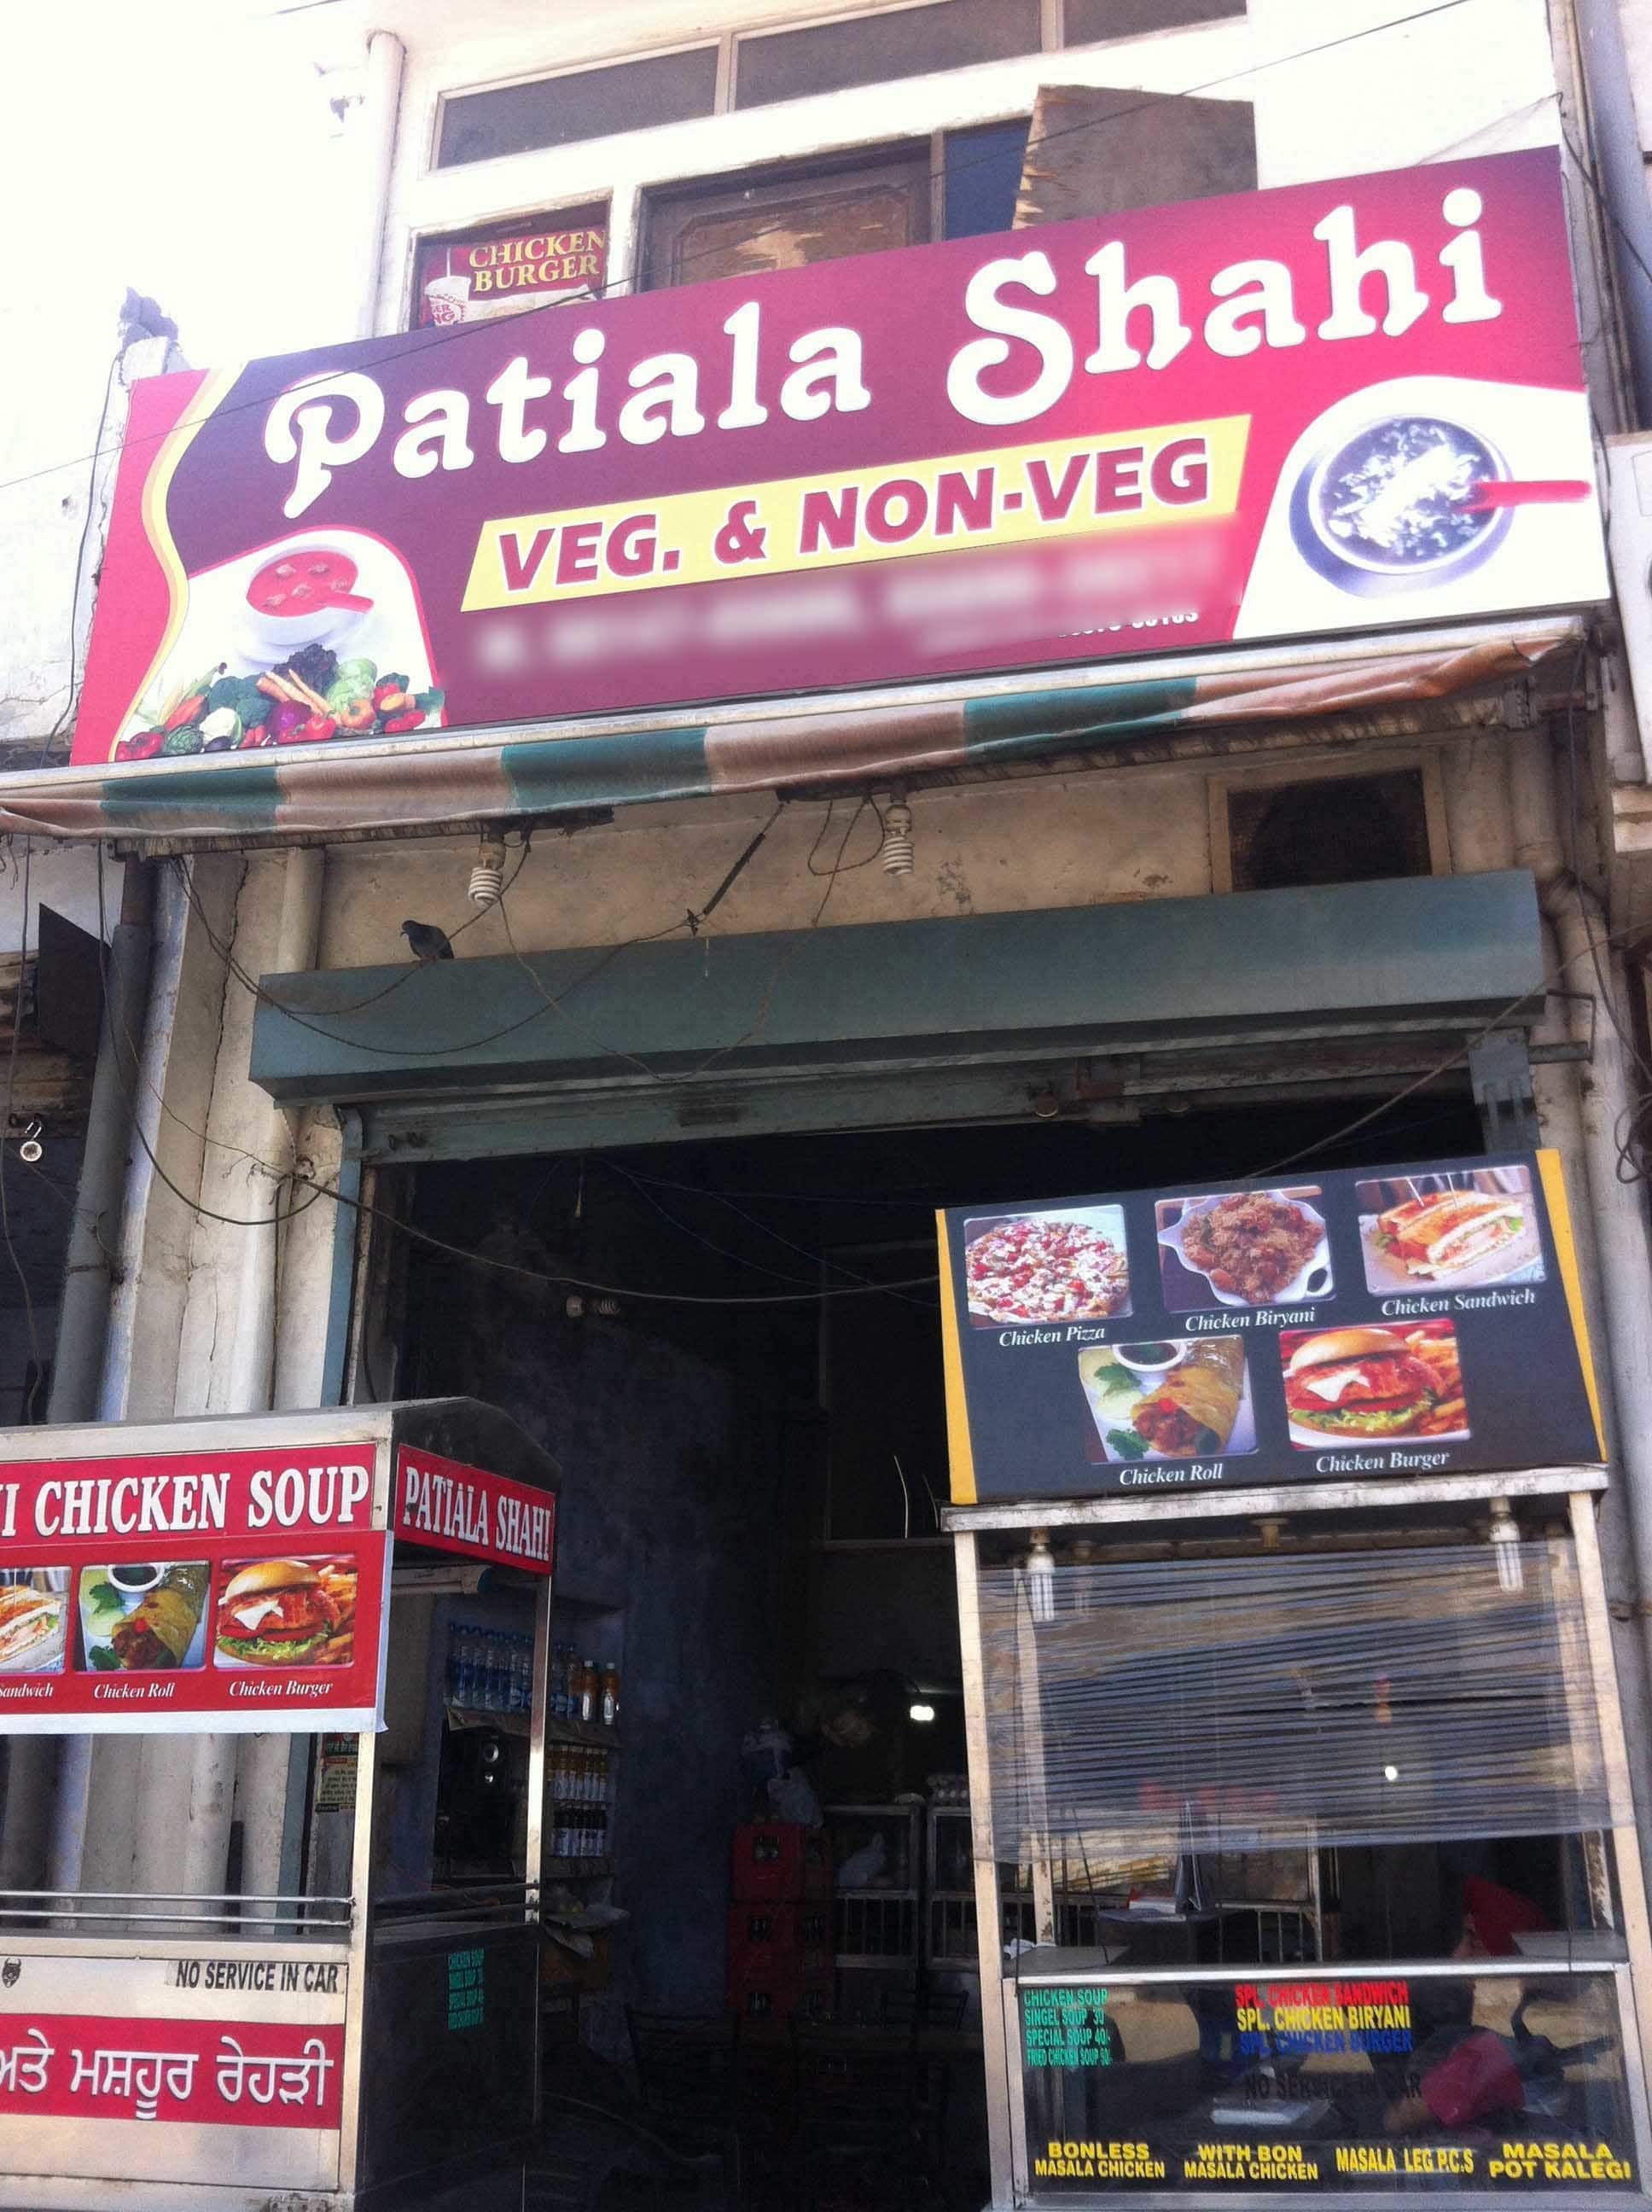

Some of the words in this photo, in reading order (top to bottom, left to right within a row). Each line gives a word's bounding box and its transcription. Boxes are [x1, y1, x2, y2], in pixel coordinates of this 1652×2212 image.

[469, 231, 605, 268] CHICKEN
[474, 255, 599, 292] BURGER
[264, 301, 870, 519] Patiala
[946, 188, 1502, 425] Shahi
[498, 514, 680, 591] VEG.
[714, 500, 766, 565] &
[800, 437, 1209, 554] NON-VEG
[1382, 1298, 1449, 1316] Chicken
[1453, 1288, 1536, 1309] Sandwich
[1185, 1312, 1250, 1331] Chicken
[1254, 1306, 1316, 1327] Biryani
[999, 1329, 1061, 1347] Chicken
[1066, 1325, 1105, 1342] Pizza
[1316, 1452, 1384, 1473] Chicken
[1389, 1450, 1451, 1470] Burger
[1120, 1466, 1184, 1485] Chicken
[1190, 1463, 1224, 1481] Roll
[34, 1473, 230, 1537] CHICKEN
[247, 1465, 369, 1528] SOUP
[403, 1466, 489, 1545] PATIALA
[495, 1495, 550, 1561] SHAHI
[93, 1683, 145, 1699] Chicken
[148, 1682, 175, 1697] Roll
[229, 1681, 282, 1697] Chicken
[286, 1680, 334, 1697] Burger
[176, 1960, 201, 1988] NO
[205, 1963, 275, 1991] SERVICE
[281, 1965, 300, 1990] IN
[304, 1966, 339, 1993] CAR
[1023, 1989, 1074, 2007] CHICKEN
[1077, 1988, 1108, 2006] SOUP
[1235, 1982, 1265, 2007] SPL.
[1268, 1982, 1331, 2007] CHICKEN
[1335, 1979, 1410, 2005] SANDWICH
[1025, 2009, 1060, 2026] SINGEL
[1062, 2008, 1088, 2026] SOUP
[1236, 2007, 1271, 2032] SPL.
[1274, 2005, 1344, 2031] CHICKEN
[1348, 2005, 1411, 2030] BIRYANI
[1026, 2028, 1065, 2046] SPECIAL
[1067, 2028, 1092, 2046] SOUP
[1276, 2029, 1346, 2054] CHICKEN
[1350, 2029, 1413, 2053] BURGER
[1048, 2048, 1079, 2066] CHICKEN
[1079, 2047, 1098, 2065] SOUP
[216, 2035, 334, 2107] ਰੇਹੜੀ
[1048, 2141, 1149, 2159] BONLESS
[1197, 2144, 1250, 2162] WITH
[1257, 2145, 1302, 2162] BON
[1335, 2147, 1397, 2174] MASALA
[1404, 2147, 1433, 2173] LEG
[1502, 2142, 1614, 2161] MASALA
[1035, 2159, 1094, 2177] MASALA
[1097, 2159, 1165, 2179] CHICKEN
[1184, 2161, 1245, 2179] MASALA
[1248, 2162, 1318, 2180] CHICKEN
[1489, 2160, 1536, 2179] POT
[1544, 2160, 1632, 2180] KALEGI
